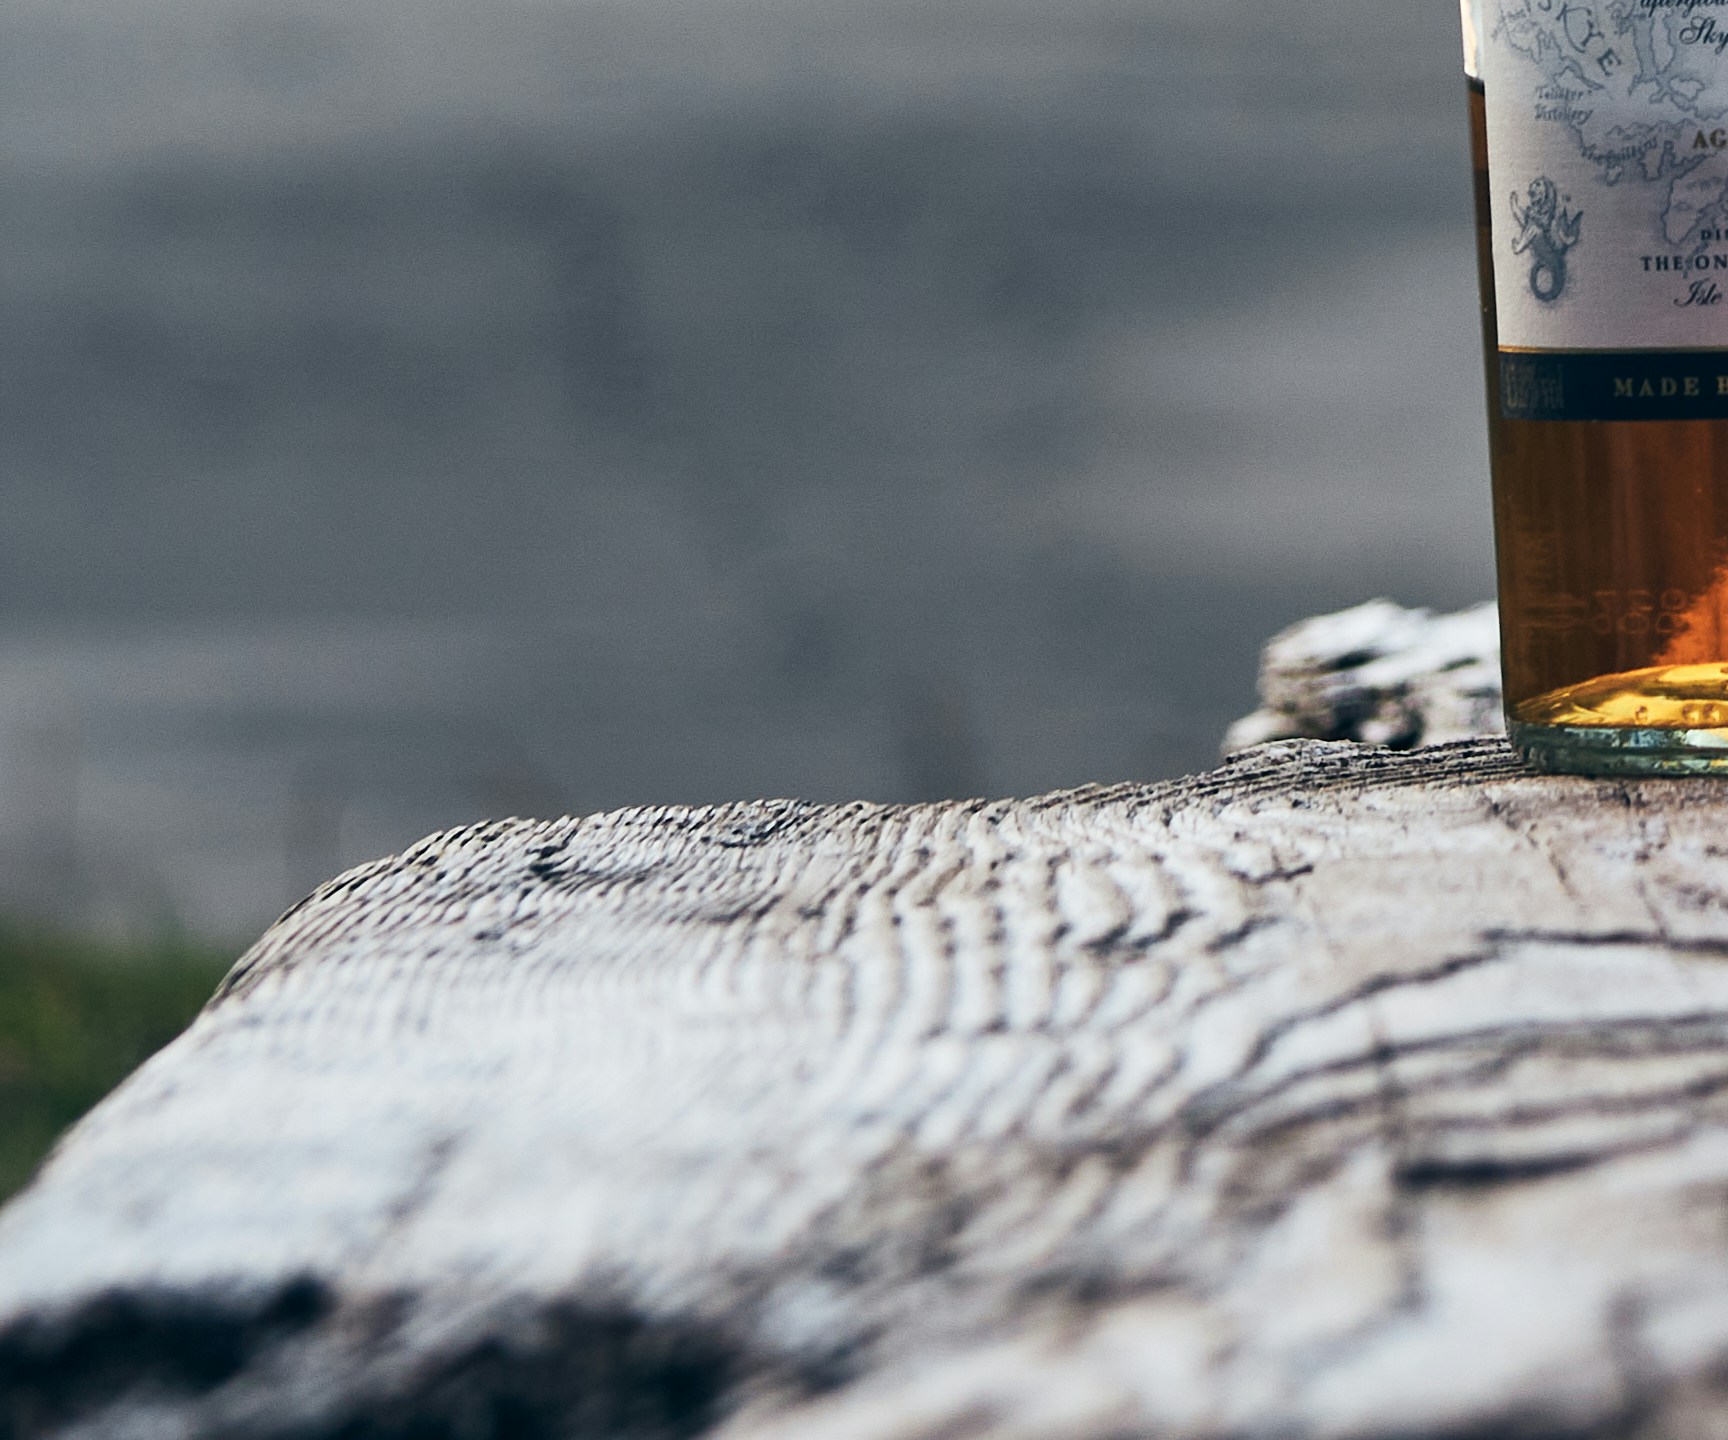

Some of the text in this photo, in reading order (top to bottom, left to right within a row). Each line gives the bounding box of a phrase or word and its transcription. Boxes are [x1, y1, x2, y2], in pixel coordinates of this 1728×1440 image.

[1640, 255, 1684, 273] THE
[1674, 277, 1723, 308] Isle
[1613, 375, 1700, 398] MADE
